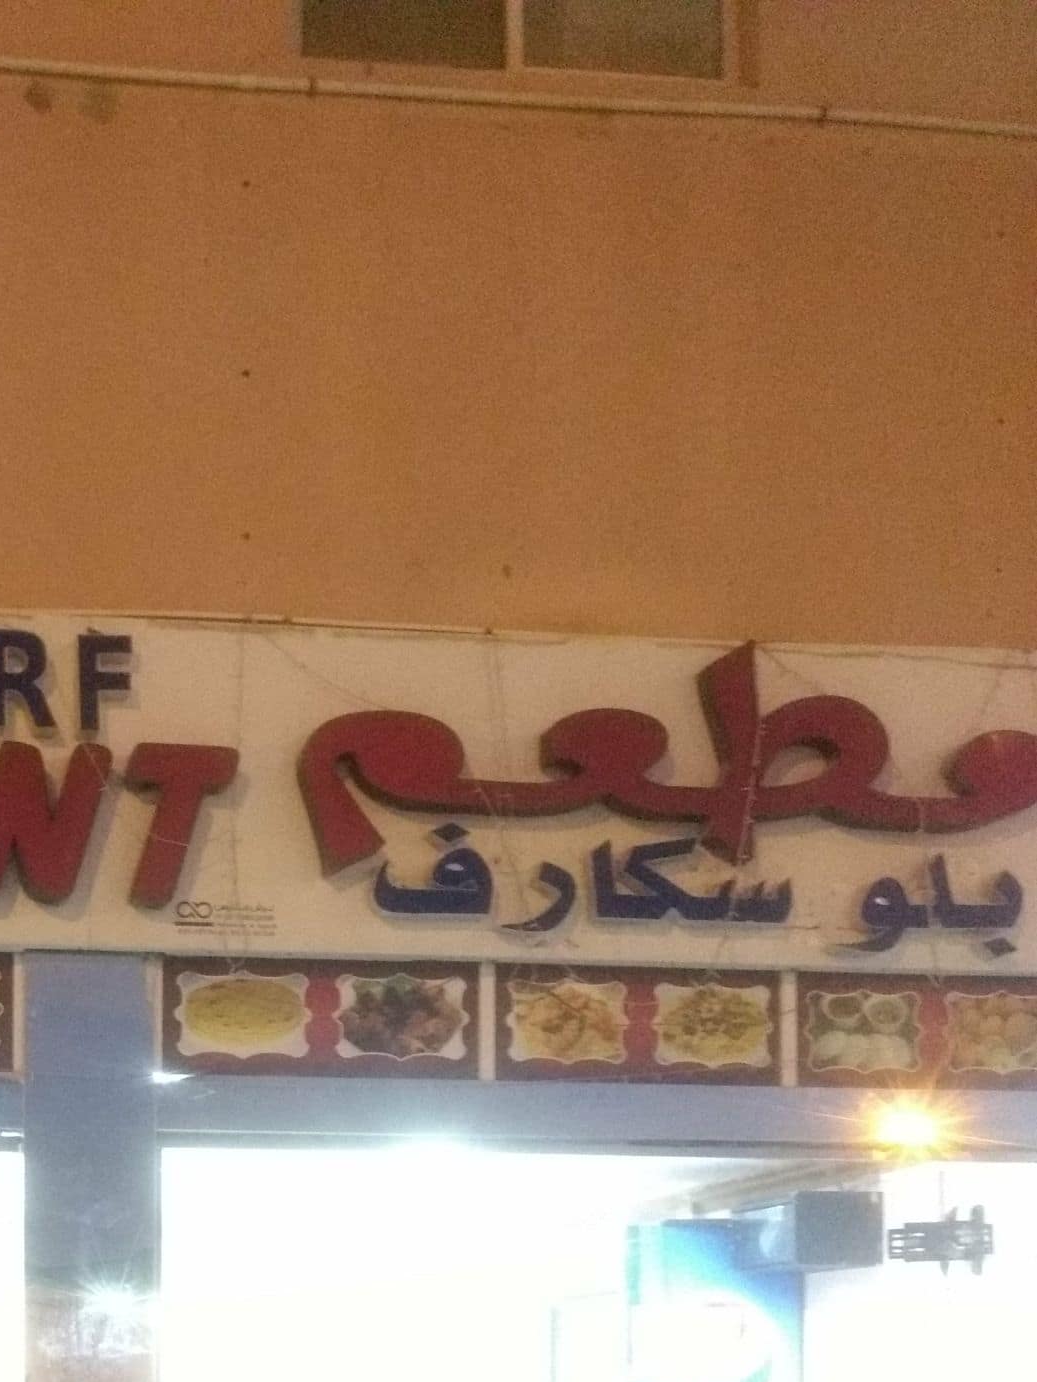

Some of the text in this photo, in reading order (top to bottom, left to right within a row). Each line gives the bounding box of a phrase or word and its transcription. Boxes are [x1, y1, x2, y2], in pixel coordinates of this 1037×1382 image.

[296, 640, 1037, 878] مطعم
[373, 822, 1024, 959] بلو سكارف
